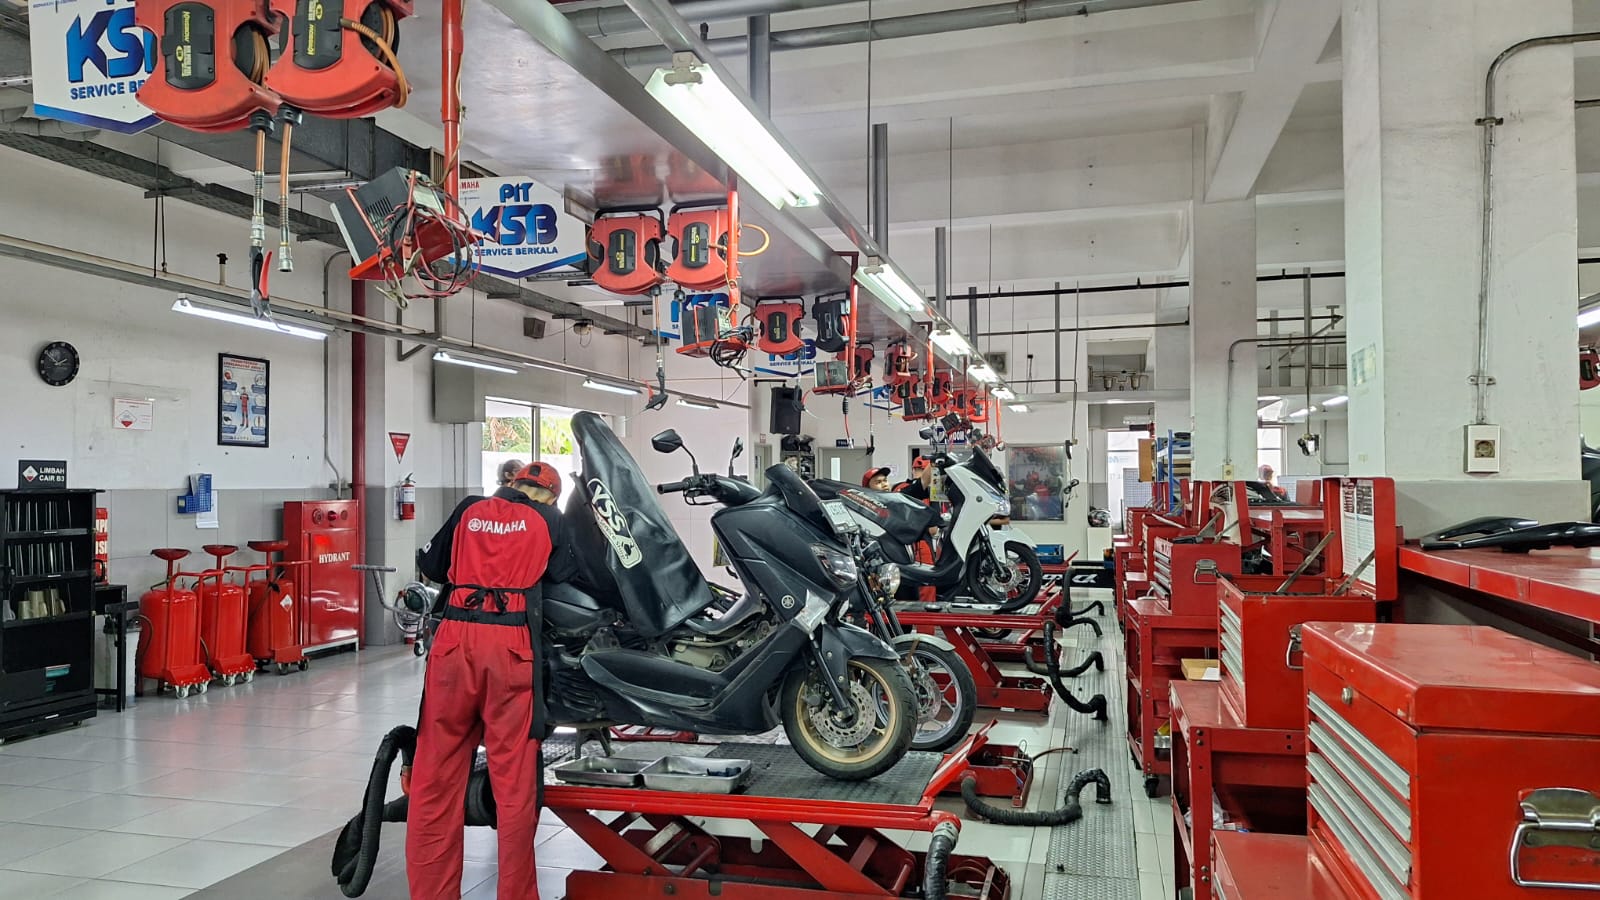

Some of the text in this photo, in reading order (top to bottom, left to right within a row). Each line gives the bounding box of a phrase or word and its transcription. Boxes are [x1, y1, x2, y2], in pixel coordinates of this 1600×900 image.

[70, 82, 125, 100] SERVICE
[460, 181, 480, 190] MAHA
[499, 182, 534, 203] PIT
[472, 203, 558, 246] KSB
[474, 246, 559, 257] SERVICE BERKALA
[592, 484, 626, 532] YSS
[481, 519, 527, 535] YAMAHA
[319, 551, 351, 564] HYDRANT
